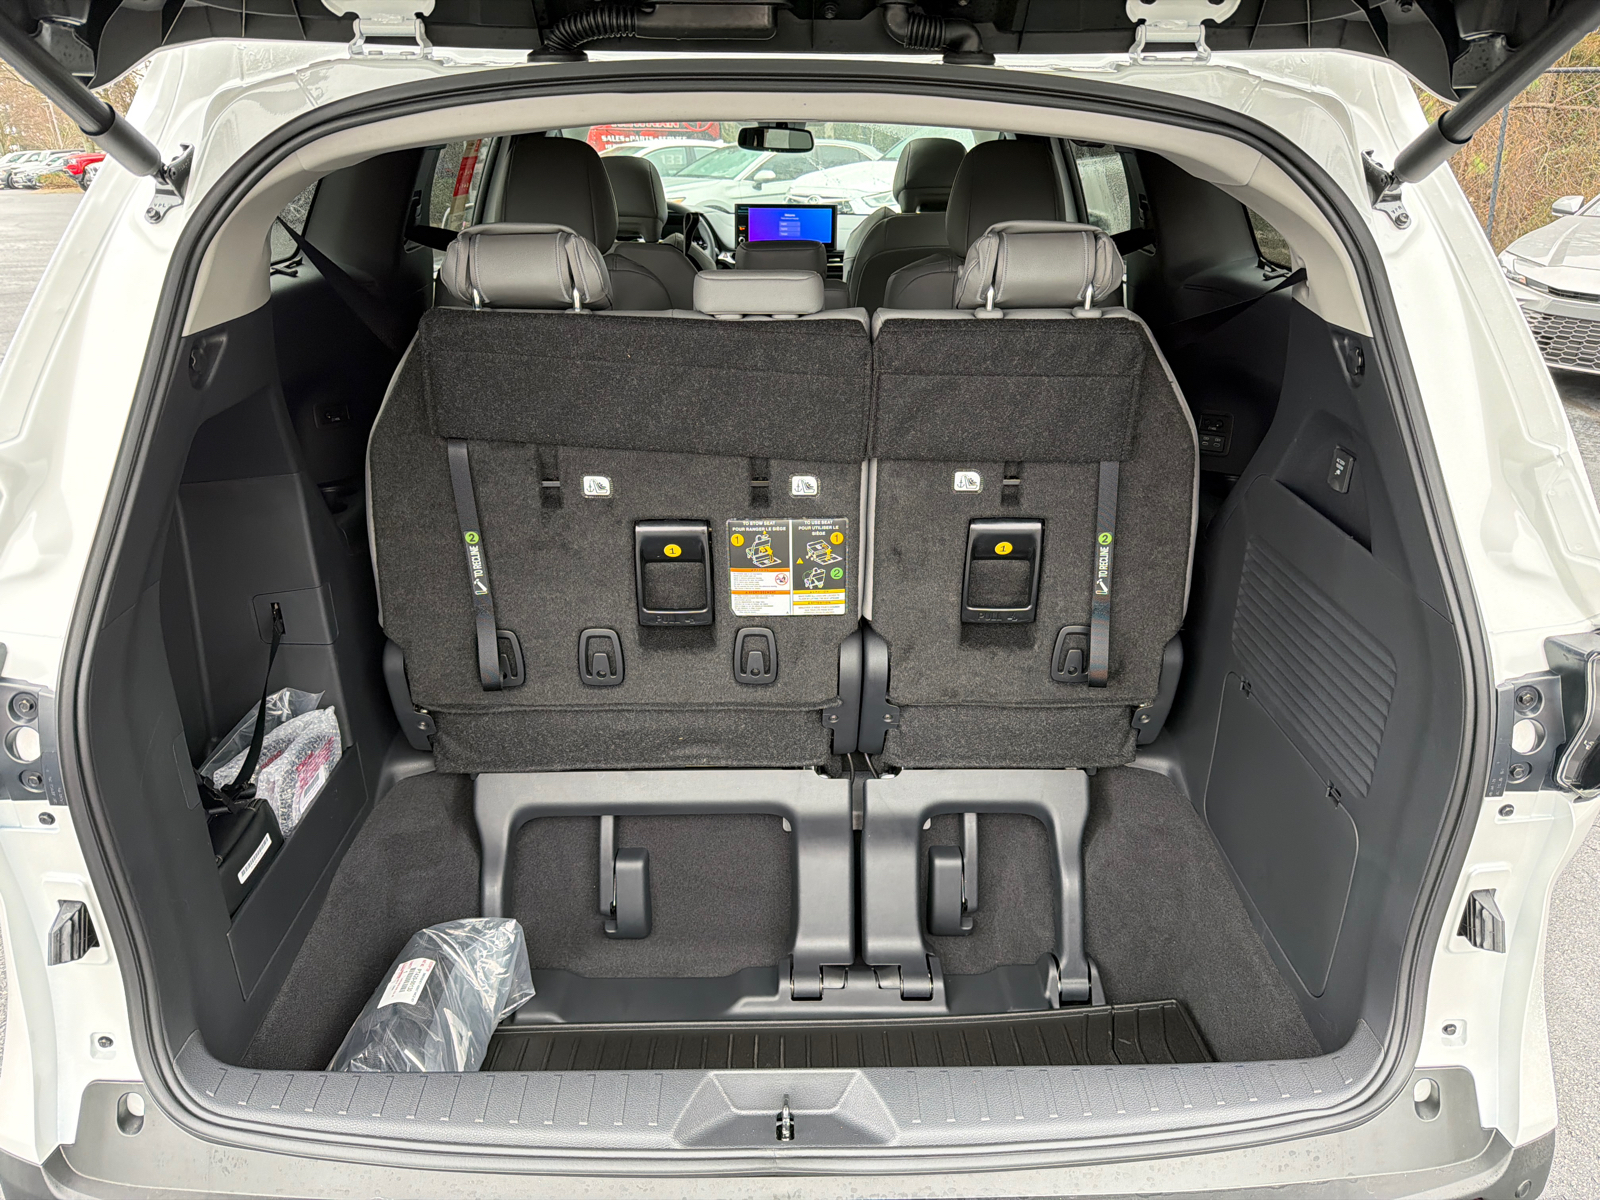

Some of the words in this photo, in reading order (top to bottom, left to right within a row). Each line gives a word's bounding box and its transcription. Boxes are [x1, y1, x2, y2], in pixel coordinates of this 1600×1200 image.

[660, 154, 683, 164] 133
[469, 545, 482, 570] RECLINE
[1098, 546, 1109, 570] RECLINE
[473, 569, 484, 578] TO
[1098, 570, 1108, 578] TO
